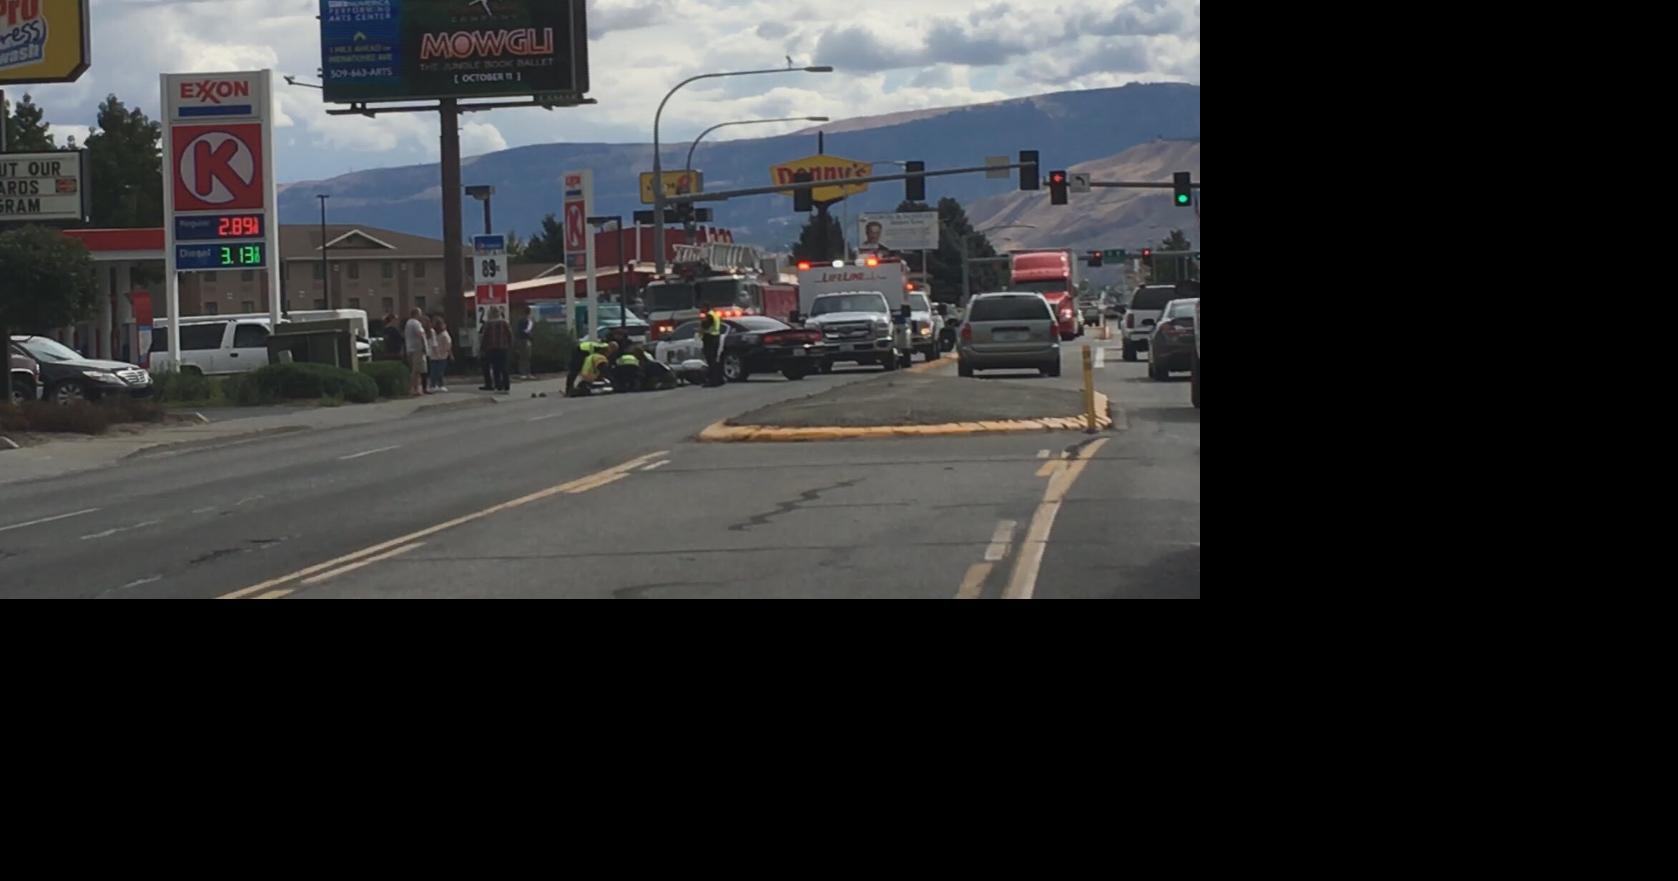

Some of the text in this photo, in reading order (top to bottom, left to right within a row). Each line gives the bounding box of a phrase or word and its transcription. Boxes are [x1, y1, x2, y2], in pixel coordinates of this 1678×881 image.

[355, 13, 391, 21] CENTER
[420, 27, 554, 59] MOWGLI
[485, 60, 511, 68] BOOK
[516, 57, 554, 67] BALLET
[462, 72, 504, 82] OCTOBER
[180, 80, 249, 104] EXXON
[28, 161, 61, 176] OUR
[776, 163, 867, 189] Dnny's
